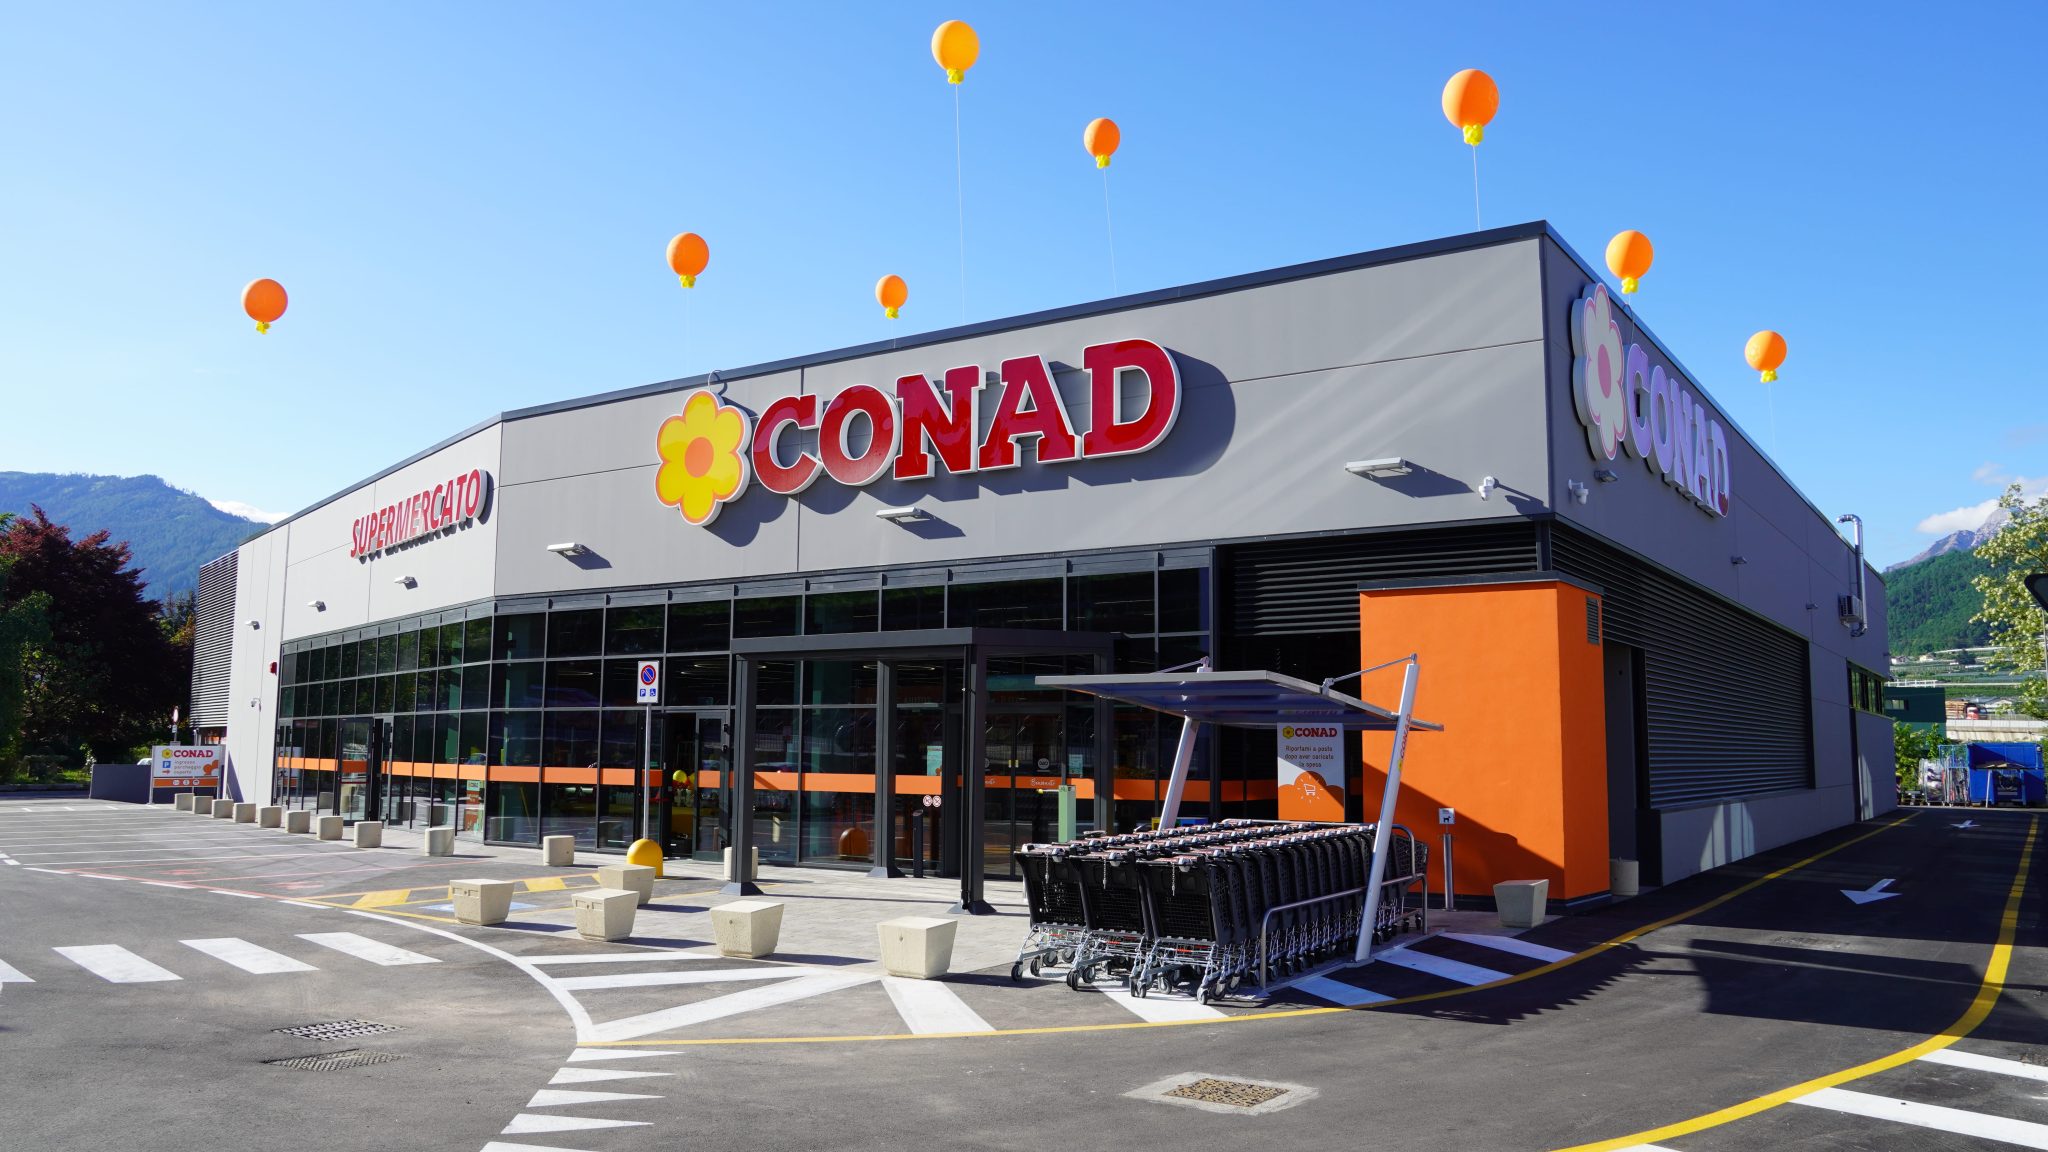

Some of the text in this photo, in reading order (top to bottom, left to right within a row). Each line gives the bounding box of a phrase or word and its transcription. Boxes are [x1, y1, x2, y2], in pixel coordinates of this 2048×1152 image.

[752, 338, 1182, 495] CONAD
[1627, 343, 1730, 518] CONAD
[350, 468, 482, 558] SUPERMERCATO
[173, 749, 214, 758] CONAD
[1295, 727, 1338, 738] CONAD
